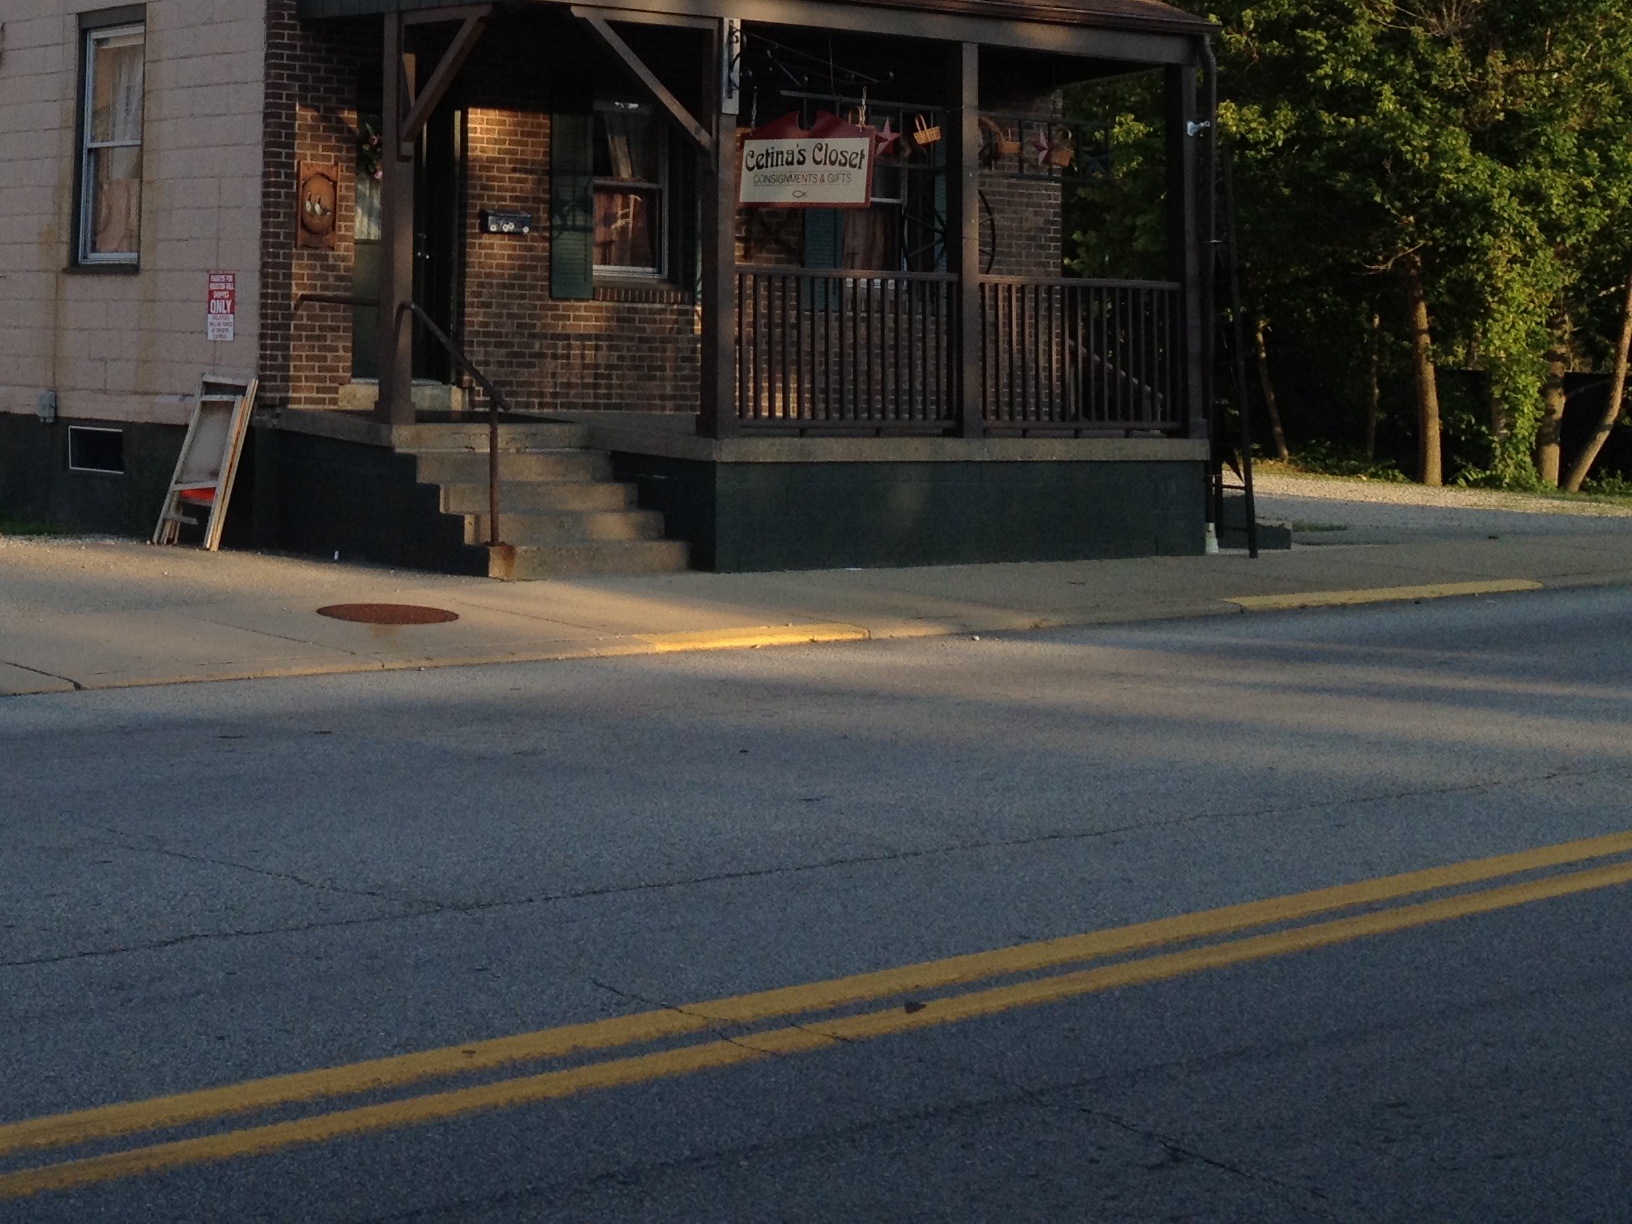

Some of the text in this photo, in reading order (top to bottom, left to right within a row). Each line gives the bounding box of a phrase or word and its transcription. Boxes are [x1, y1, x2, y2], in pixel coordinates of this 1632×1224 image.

[745, 142, 866, 172] Cetina's Closet
[753, 173, 852, 184] CONSIGNMENTS & GIFTS
[210, 299, 232, 314] ONLY
